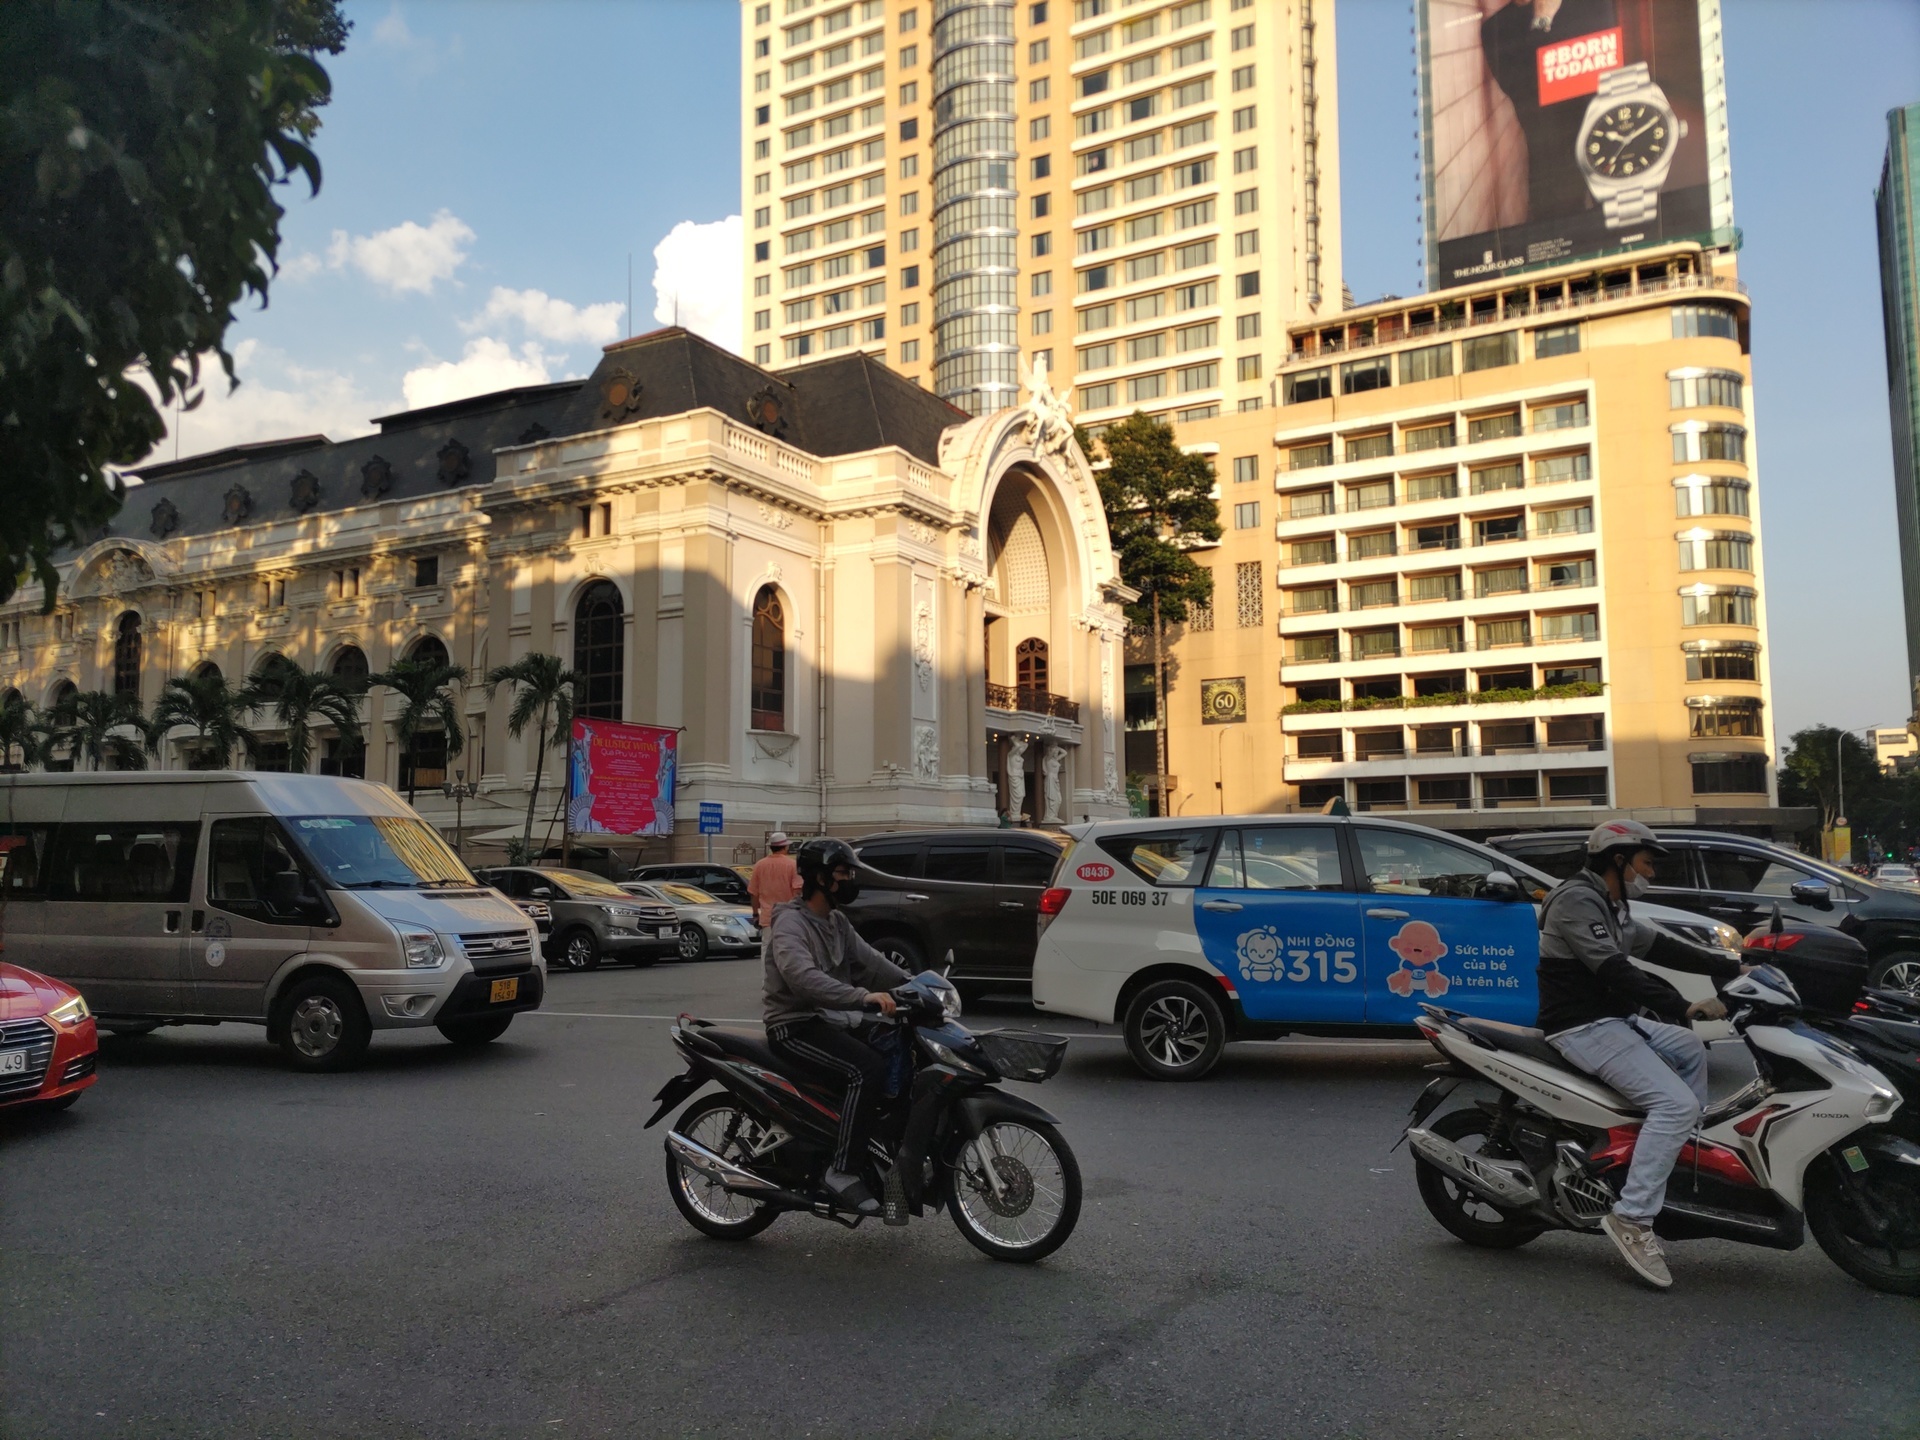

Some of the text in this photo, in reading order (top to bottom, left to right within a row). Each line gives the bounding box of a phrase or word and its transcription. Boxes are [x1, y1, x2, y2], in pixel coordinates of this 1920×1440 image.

[1543, 33, 1618, 68] #BORN
[1543, 51, 1618, 83] TODARE
[1496, 256, 1525, 270] GLASS
[1215, 694, 1234, 709] 60
[1080, 866, 1110, 878] 18436
[1092, 890, 1168, 906] 50E 069 37
[1287, 932, 1355, 948] NHI ĐỒNG
[1455, 944, 1515, 957] Sức khoẻ
[1287, 950, 1357, 983] 315
[1463, 958, 1507, 970] của bé
[1451, 975, 1519, 988] là trên hết
[867, 1145, 894, 1165] HONDA
